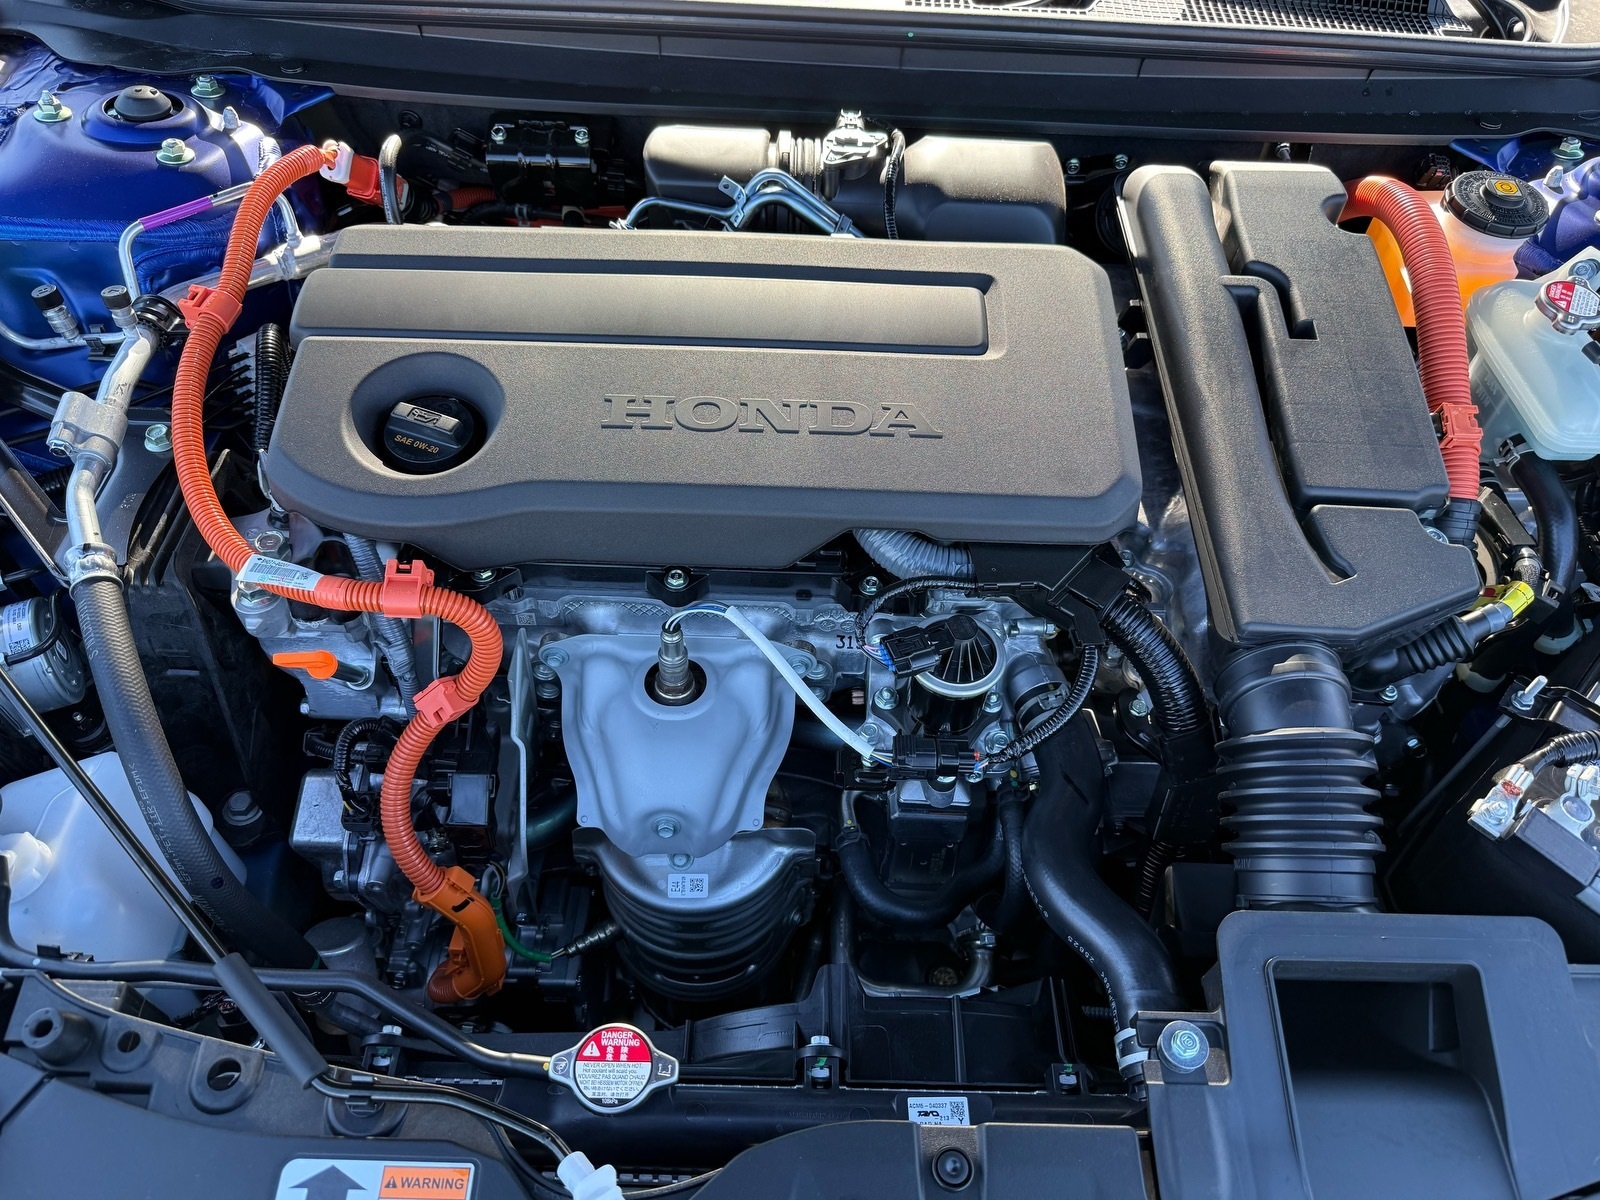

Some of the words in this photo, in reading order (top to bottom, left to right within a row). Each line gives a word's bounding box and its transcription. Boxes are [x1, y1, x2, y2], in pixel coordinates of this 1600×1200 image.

[600, 393, 944, 440] HONDA
[394, 434, 414, 446] SAE
[413, 440, 440, 454] 0W-20
[957, 1117, 965, 1125] Y
[400, 1175, 465, 1190] WARNING
